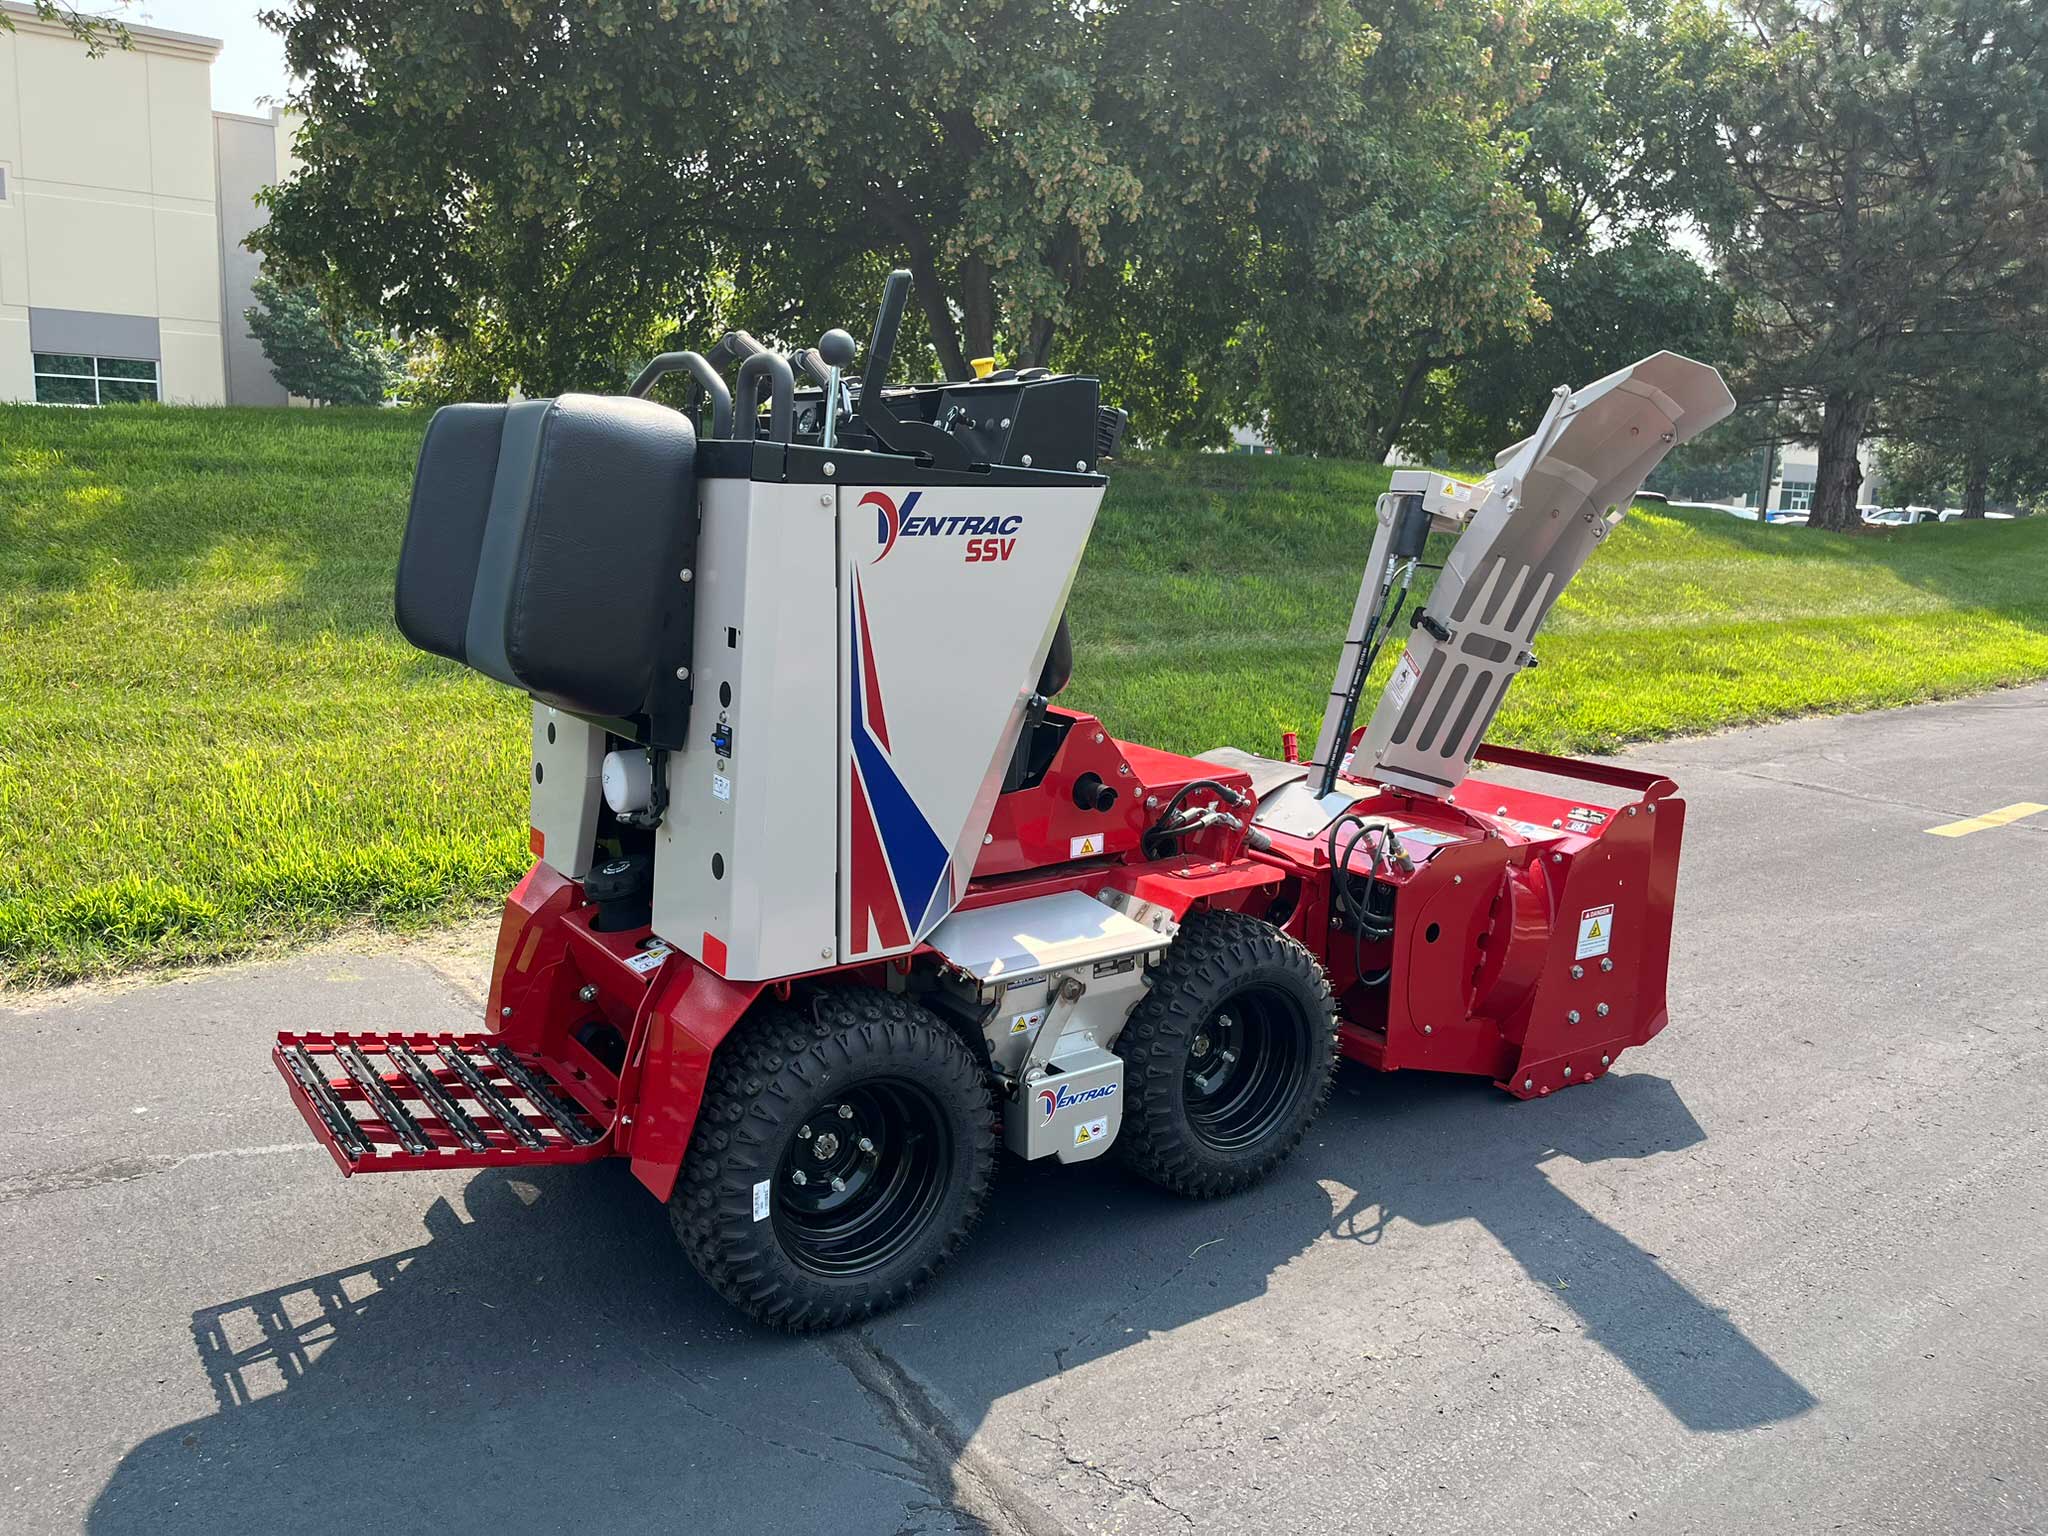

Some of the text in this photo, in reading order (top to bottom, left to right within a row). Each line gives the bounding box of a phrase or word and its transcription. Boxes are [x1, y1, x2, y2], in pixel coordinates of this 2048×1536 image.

[860, 491, 1023, 559] VENTRAC
[965, 538, 1016, 562] SSV
[1040, 1084, 1117, 1121] VENTRAC
